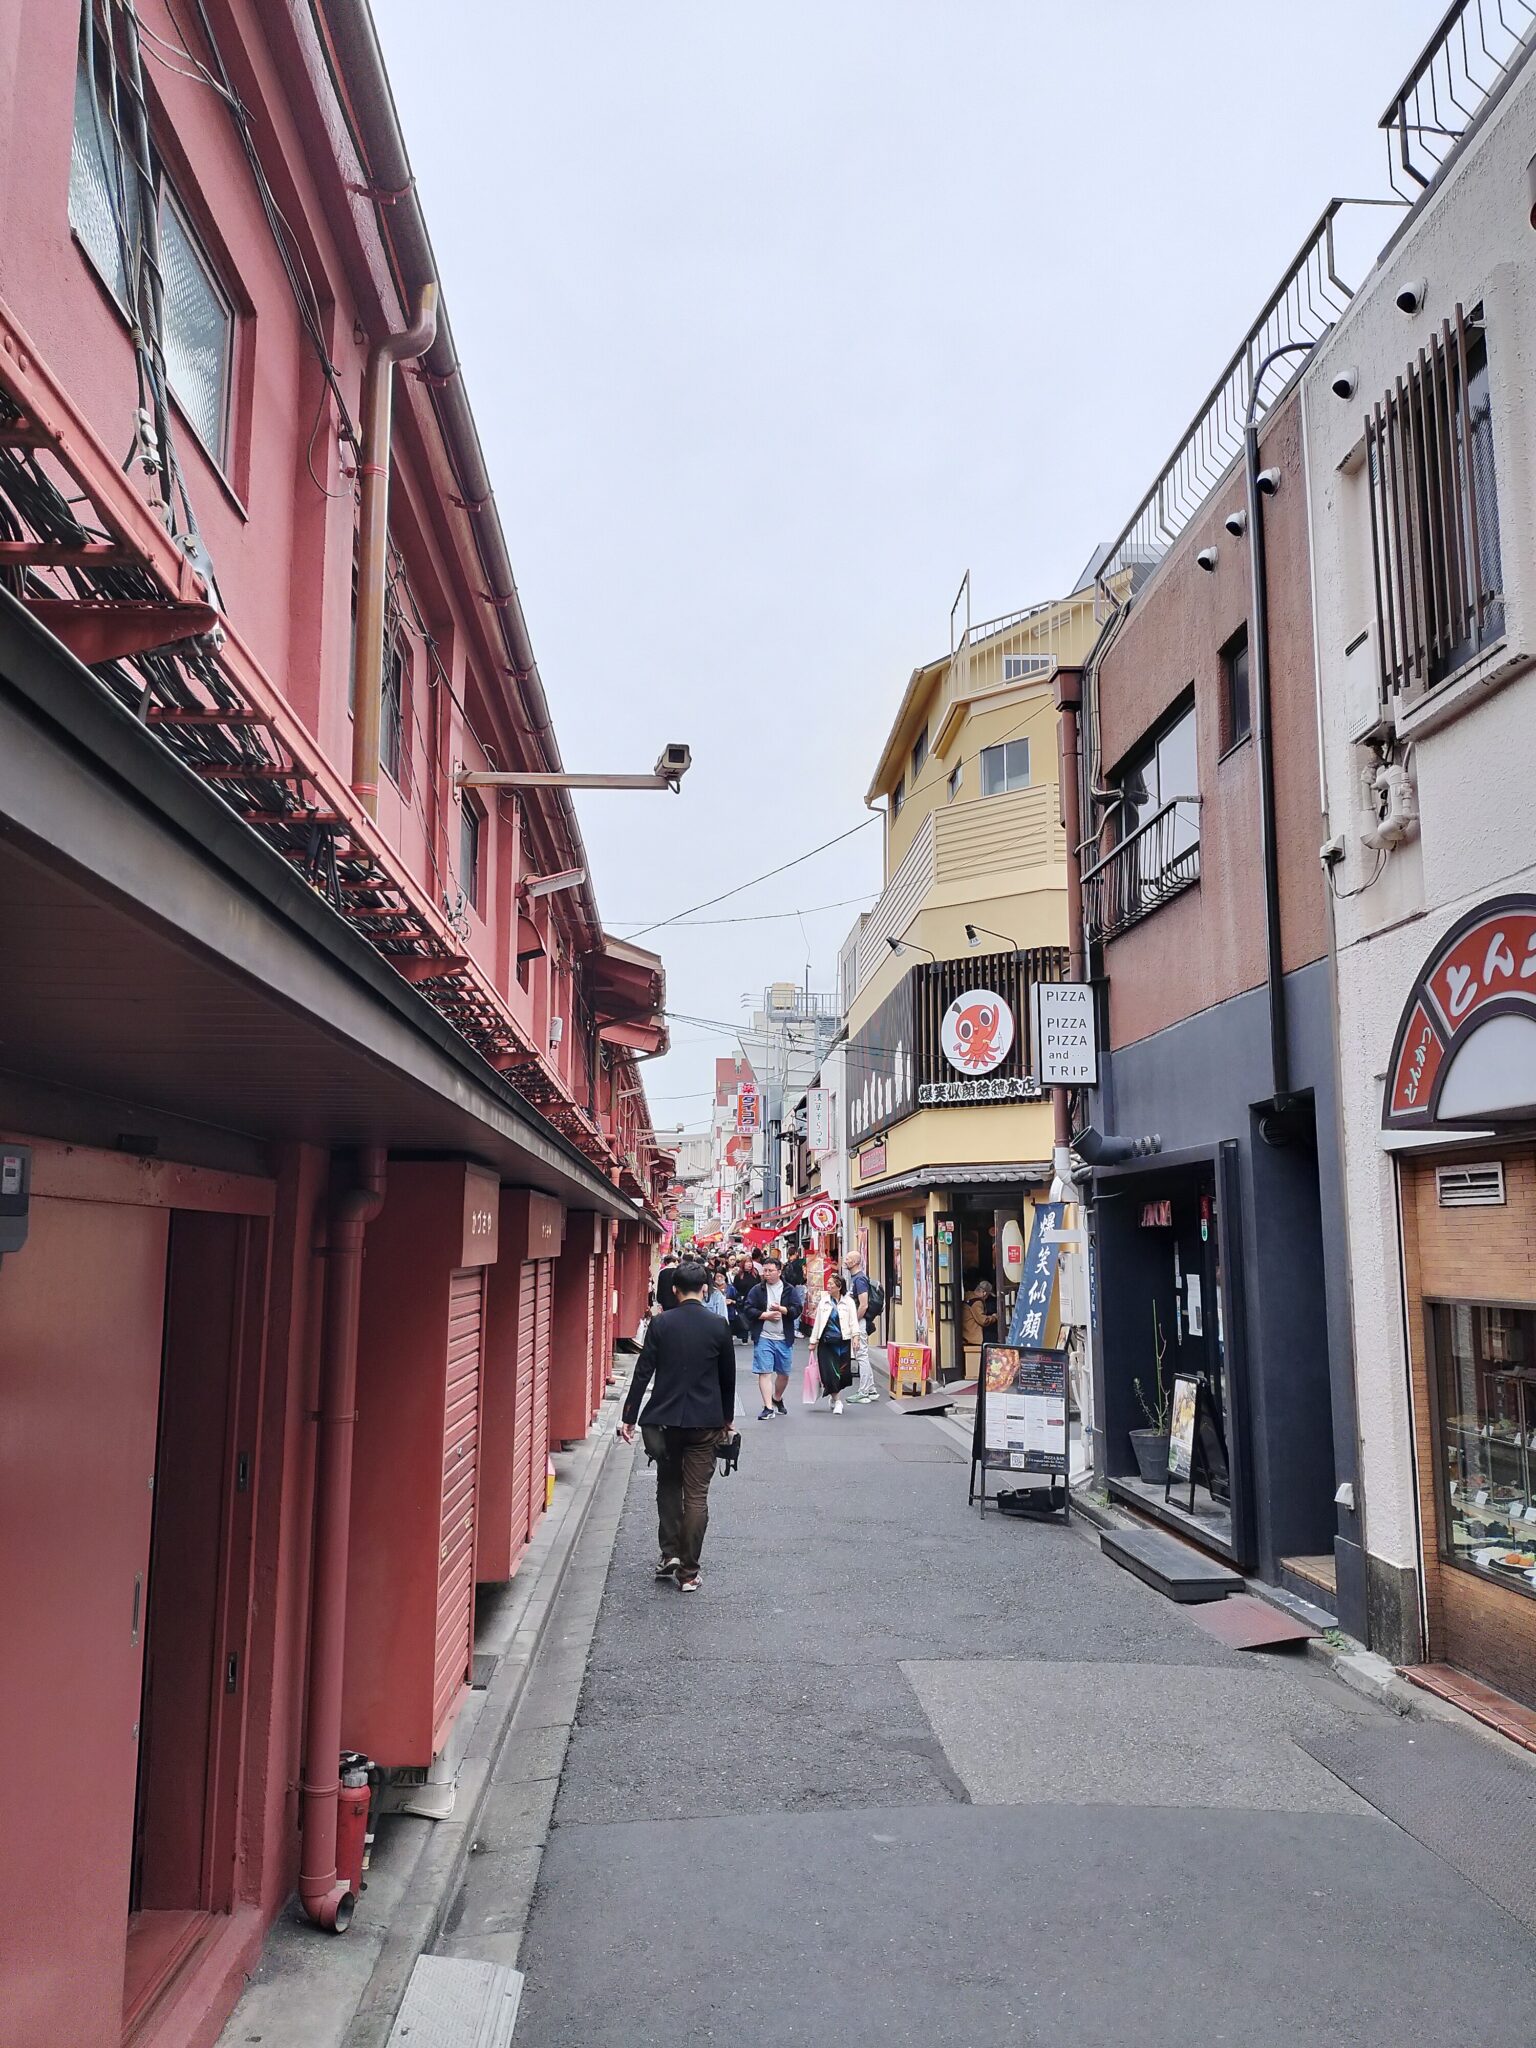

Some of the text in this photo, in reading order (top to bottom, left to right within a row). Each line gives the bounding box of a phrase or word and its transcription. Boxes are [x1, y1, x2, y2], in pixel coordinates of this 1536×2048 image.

[1046, 991, 1087, 1002] PIZZA
[1047, 1018, 1088, 1029] PIZZA
[1047, 1035, 1088, 1046] PIZZA
[1048, 1050, 1069, 1060] and
[1048, 1065, 1089, 1077] TRIP
[1404, 1026, 1432, 1105] とんかつ
[1019, 1211, 1056, 1347] 爆笑似顔
